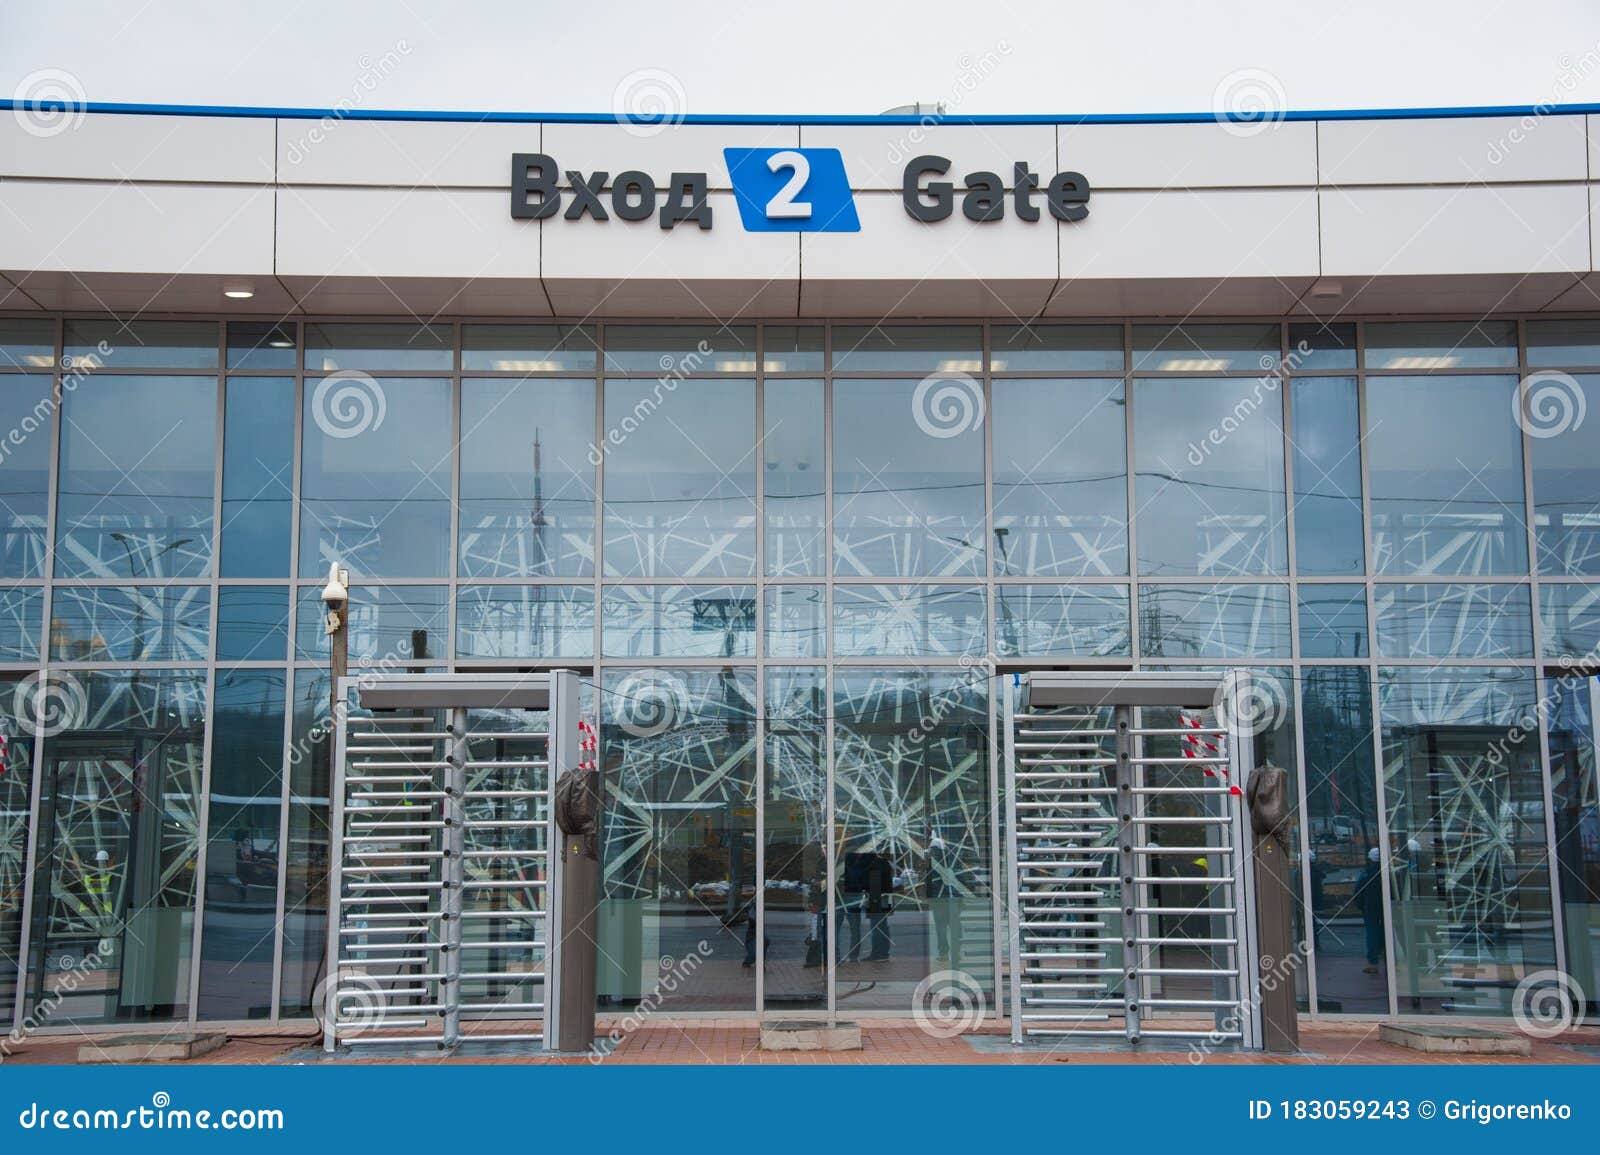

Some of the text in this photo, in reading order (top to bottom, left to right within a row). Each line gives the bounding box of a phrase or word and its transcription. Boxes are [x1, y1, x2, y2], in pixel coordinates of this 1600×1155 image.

[511, 151, 1091, 230] Вход 2 Gate
